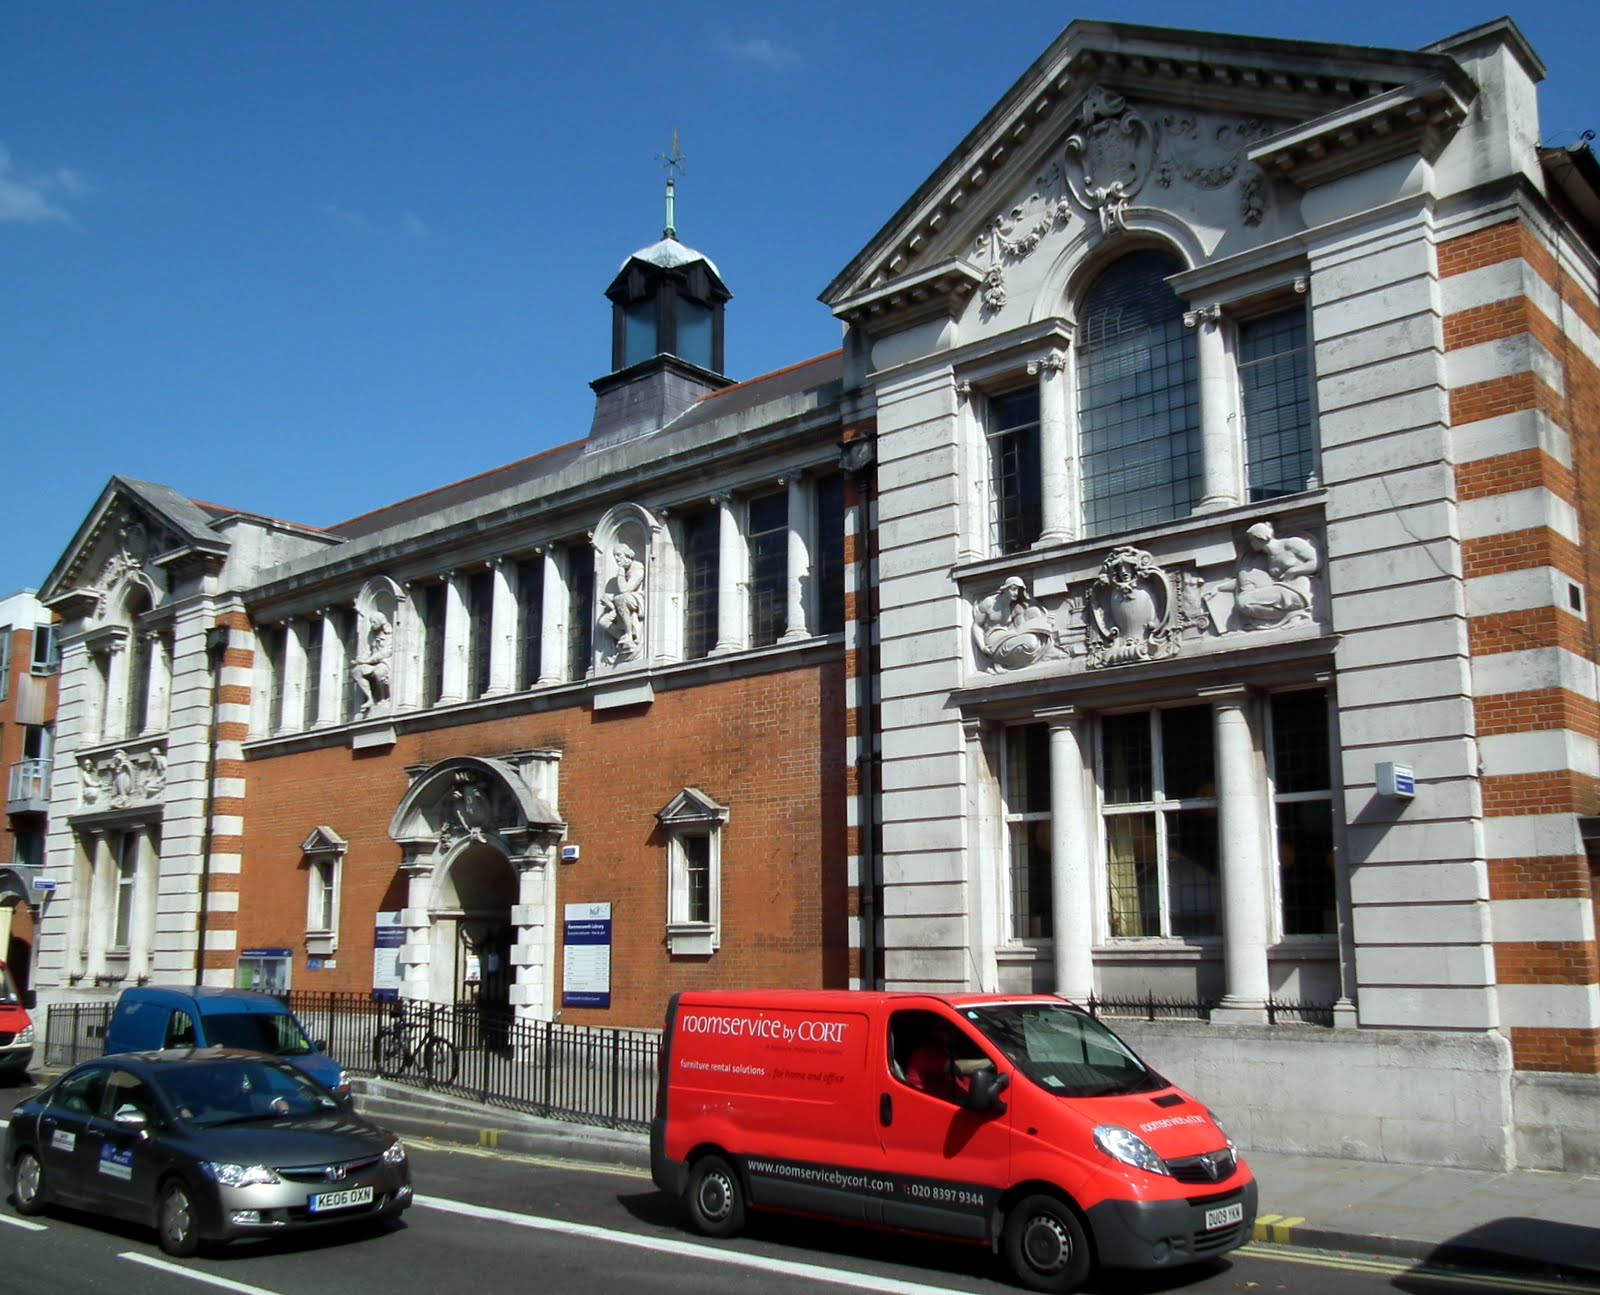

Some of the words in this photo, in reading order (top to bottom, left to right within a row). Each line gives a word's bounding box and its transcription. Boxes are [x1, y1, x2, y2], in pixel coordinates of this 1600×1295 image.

[682, 1013, 781, 1038] roomservice
[783, 1024, 796, 1043] by
[798, 1021, 846, 1043] CORT
[680, 1058, 710, 1070] furniture
[711, 1063, 731, 1072] rental
[732, 1064, 765, 1076] solutions
[807, 1072, 822, 1081] and
[747, 1160, 894, 1192] www.roomservicebycort.com
[912, 1184, 931, 1198] 020
[932, 1187, 956, 1202] 8397
[958, 1191, 984, 1206] 9344
[318, 1192, 348, 1208] KE06
[350, 1188, 371, 1203] OXN
